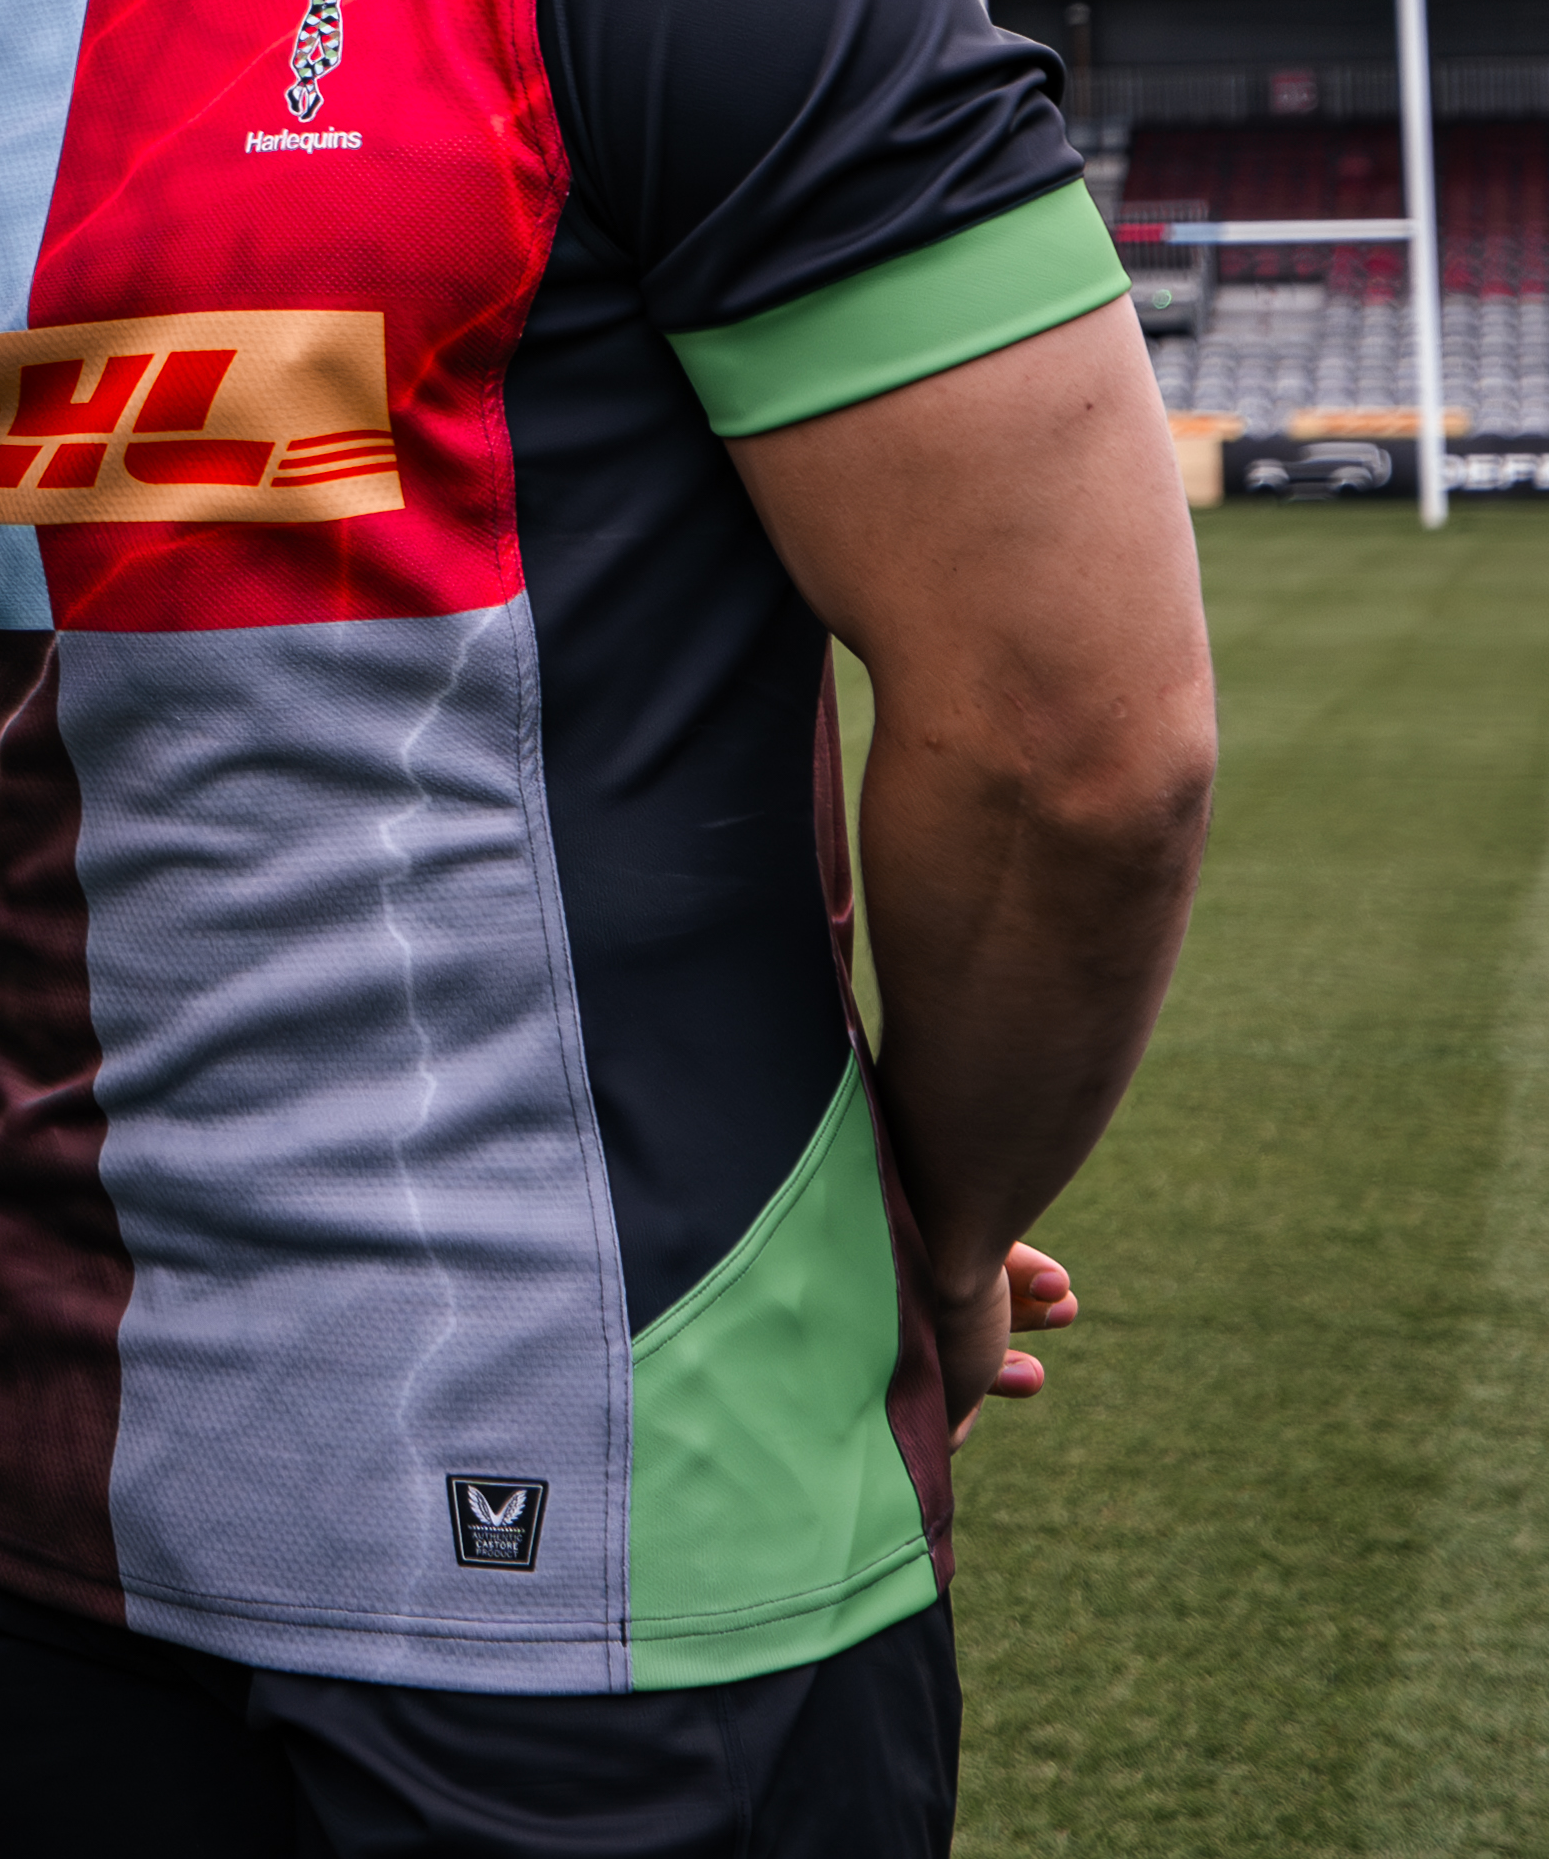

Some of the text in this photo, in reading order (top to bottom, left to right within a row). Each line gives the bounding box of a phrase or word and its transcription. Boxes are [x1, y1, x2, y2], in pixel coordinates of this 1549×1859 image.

[245, 127, 363, 154] Harlequins
[472, 1532, 523, 1542] AUTHENTIC
[475, 1541, 519, 1551] CASTORE
[475, 1548, 519, 1558] PRODUCT
